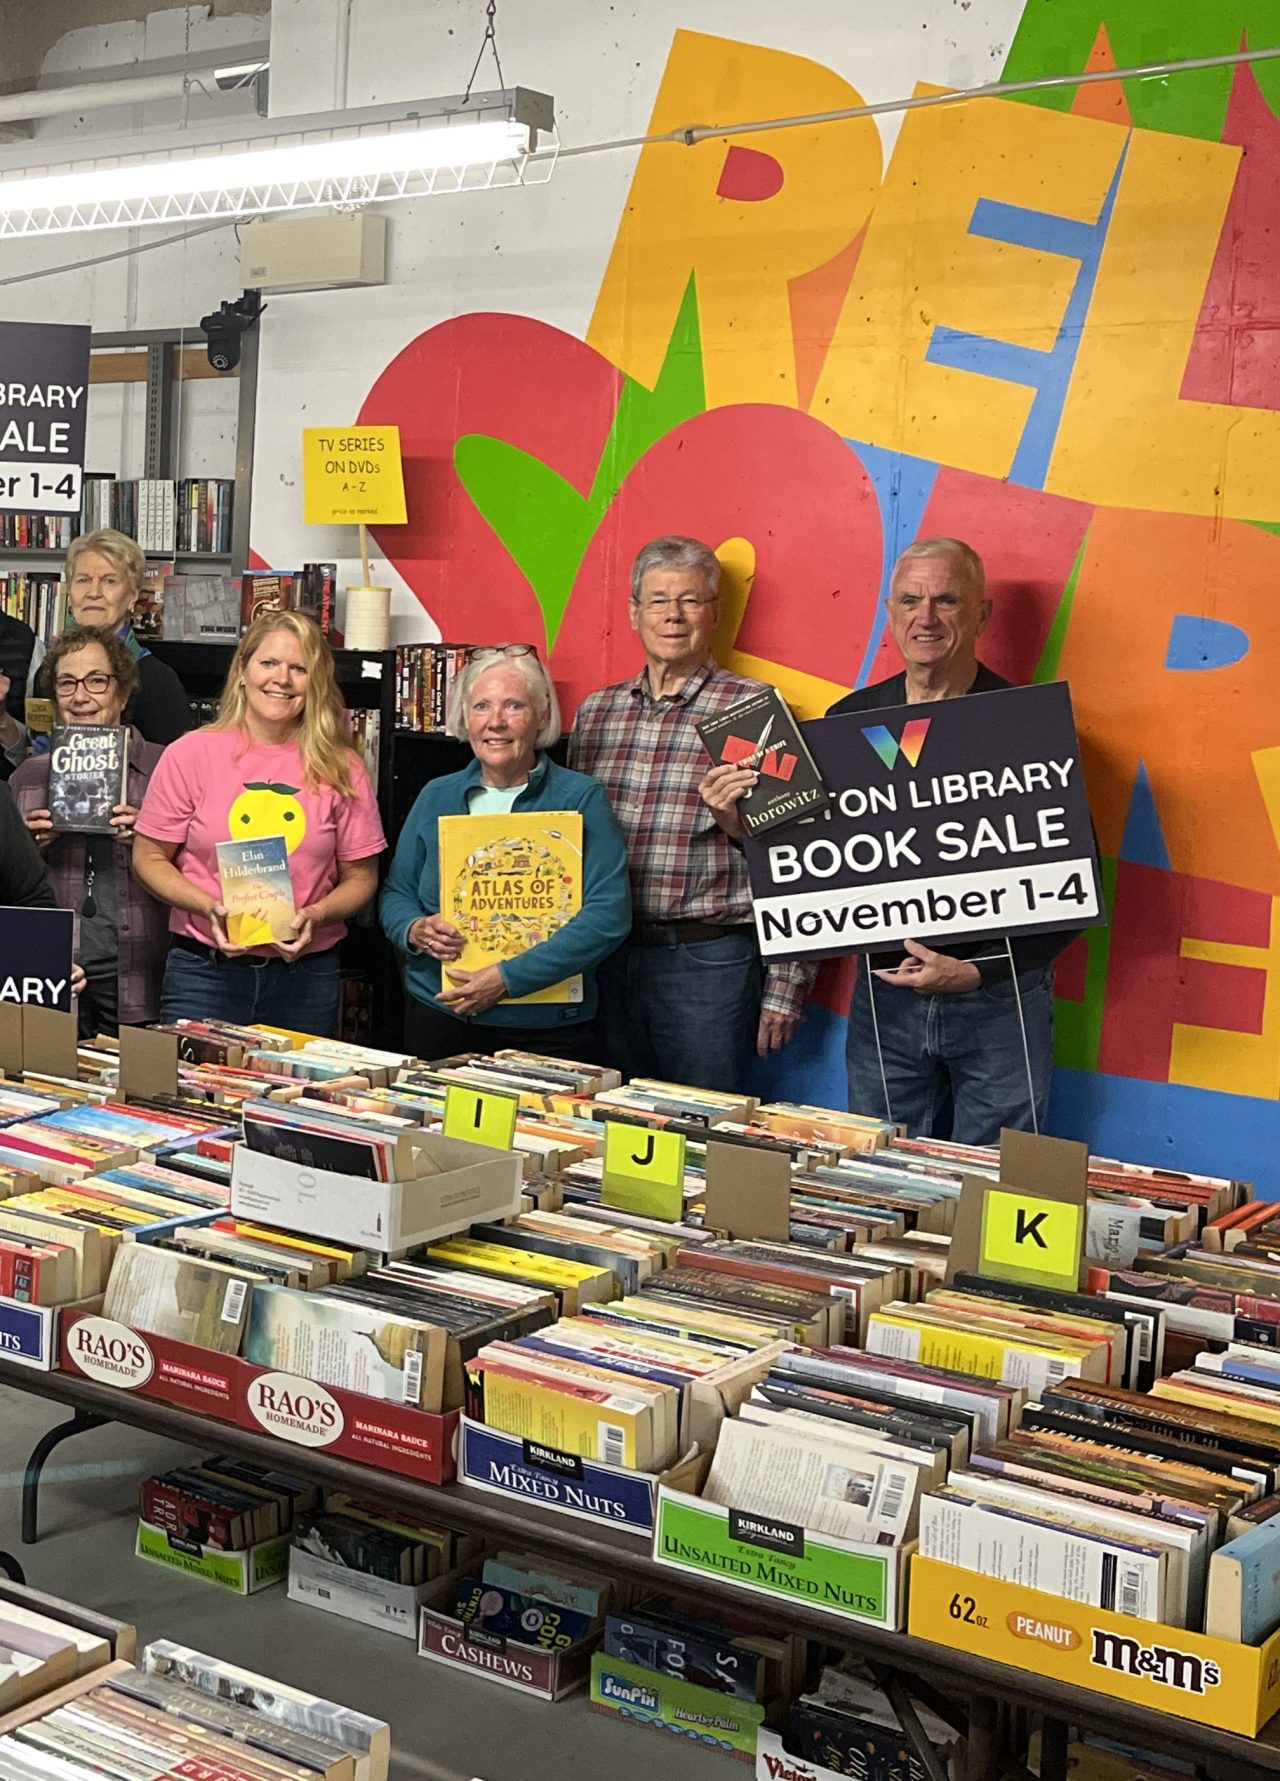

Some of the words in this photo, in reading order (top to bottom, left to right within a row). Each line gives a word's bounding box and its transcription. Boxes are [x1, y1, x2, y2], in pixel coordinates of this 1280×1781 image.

[319, 439, 334, 452] TV
[339, 438, 384, 452] SERIES
[325, 461, 345, 473] ON
[349, 461, 380, 473] DVDs
[30, 473, 76, 499] 1-4
[342, 482, 349, 492] A
[359, 482, 366, 492] Z
[69, 733, 117, 750] Great
[52, 746, 119, 773] Ghost
[65, 771, 105, 780] STORIES
[910, 757, 1074, 808] LIBRARY
[746, 788, 818, 828] horowitz
[242, 850, 264, 862] Elin
[768, 827, 920, 883] BOOK
[936, 806, 1070, 861] SALE
[223, 860, 286, 878] Hilderbrand
[471, 880, 524, 896] ATLAS
[530, 879, 555, 895] OF
[470, 897, 554, 910] ADVENTURES
[761, 886, 1007, 942] November
[1019, 872, 1087, 911] 1-4
[630, 1135, 655, 1166] J
[1015, 1209, 1049, 1249] K
[77, 1328, 145, 1368] RAO'S
[83, 1354, 138, 1378] HOMEMADE
[162, 1362, 202, 1382] MARINARA
[203, 1374, 227, 1389] SAUCE
[170, 1377, 193, 1391] NATURAL
[193, 1382, 229, 1400] INGREDIENTS
[258, 1382, 335, 1427] RAO'S
[265, 1412, 327, 1437] HOMEMADE
[355, 1420, 399, 1441] MARINARA
[401, 1433, 429, 1448] SAUCE
[1052, 1409, 1099, 1425] Stephen
[1102, 1420, 1132, 1433] King
[364, 1436, 390, 1450] NATURAL
[391, 1442, 432, 1462] INGREDIENTS
[1030, 1425, 1097, 1445] STEPHEN
[1105, 1443, 1142, 1457] KING
[529, 1444, 575, 1467] KIRKLAND
[489, 1462, 559, 1501] MIXED
[564, 1488, 626, 1520] NUTS
[737, 1517, 795, 1542] KIRKLAND
[141, 1545, 182, 1566] UNSALTED
[664, 1533, 752, 1576] UNSALTED
[757, 1563, 819, 1595] MIXED
[823, 1582, 877, 1612] NUTS
[949, 1592, 976, 1624] 62
[1016, 1615, 1072, 1647] PEANUT
[441, 1635, 533, 1681] CASHEWS
